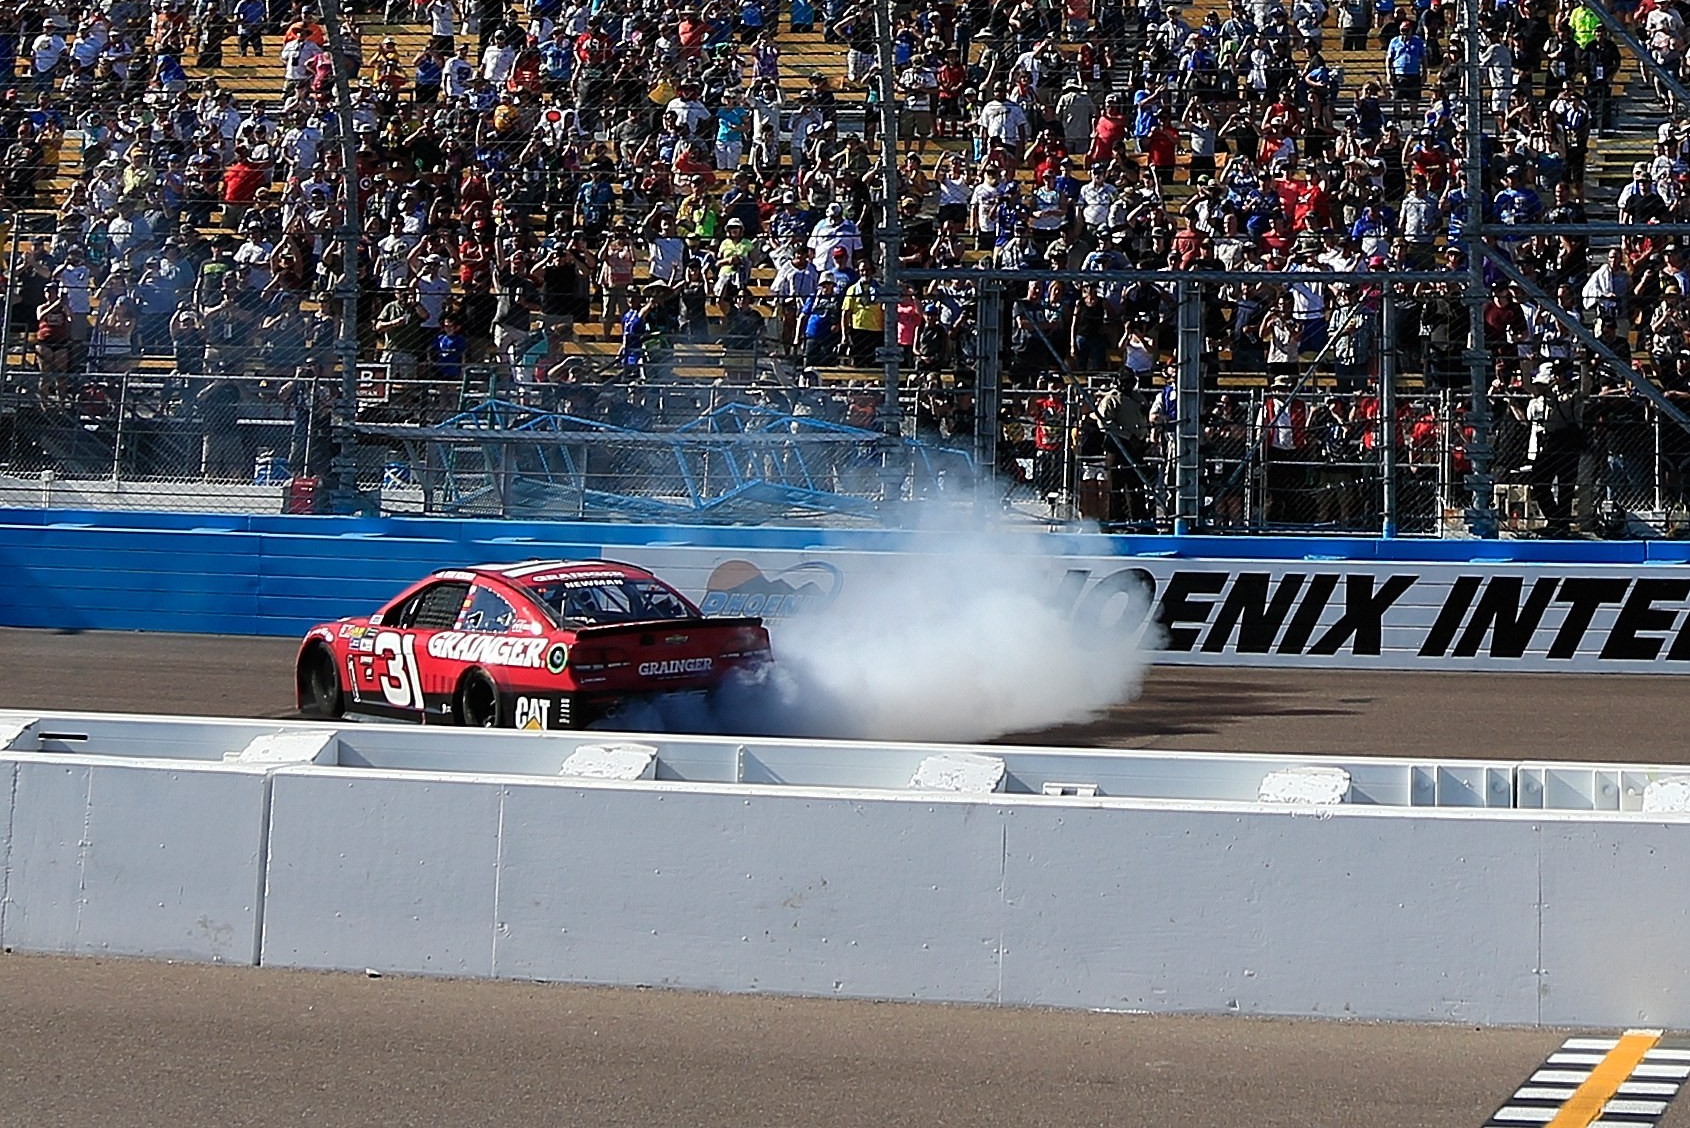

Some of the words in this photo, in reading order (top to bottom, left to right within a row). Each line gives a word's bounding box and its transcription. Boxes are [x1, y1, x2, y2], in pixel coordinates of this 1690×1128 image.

[564, 579, 624, 589] NEWMAN
[374, 631, 425, 709] 31
[639, 658, 713, 676] GRAINGER
[515, 696, 551, 730] CAT
